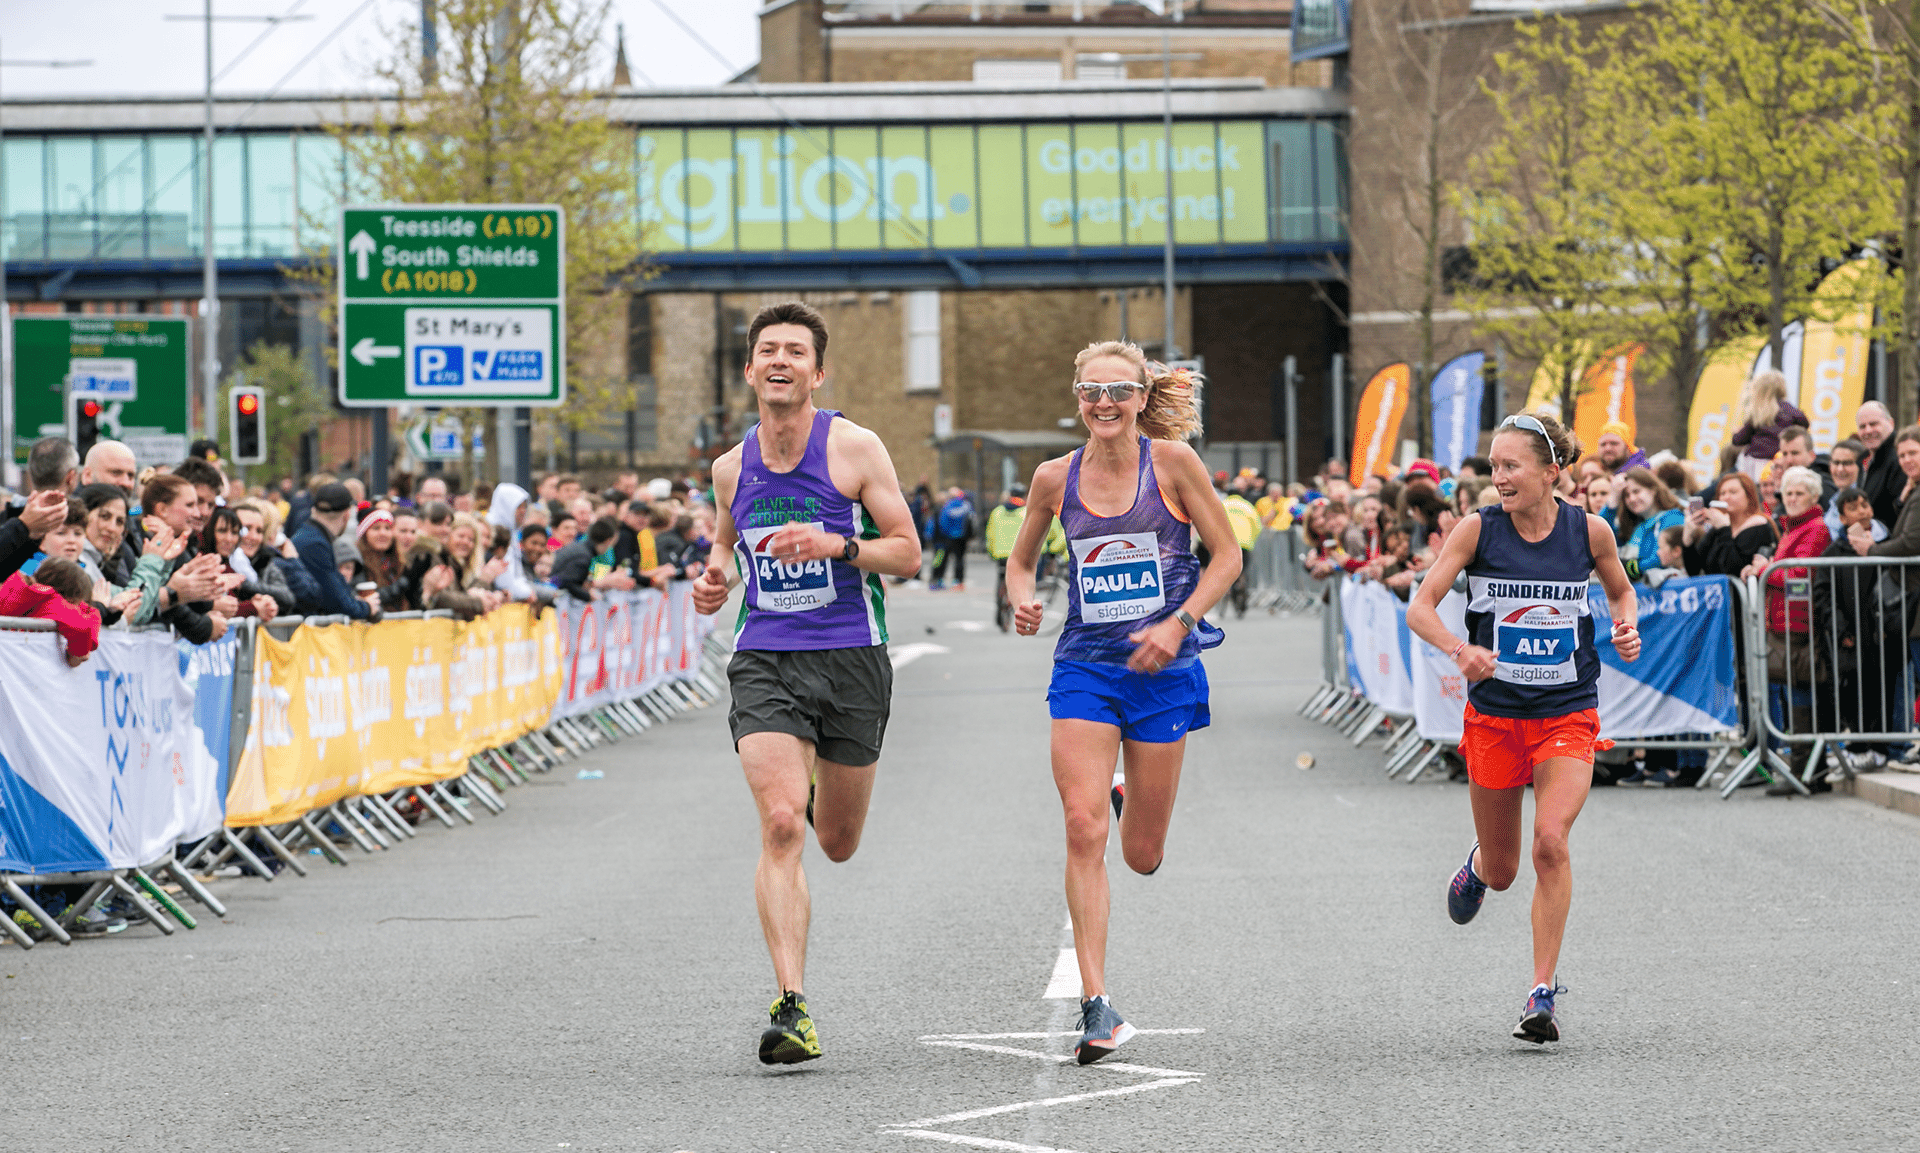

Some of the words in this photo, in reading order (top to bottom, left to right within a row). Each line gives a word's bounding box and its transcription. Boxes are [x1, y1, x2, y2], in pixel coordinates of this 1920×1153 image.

[1038, 138, 1150, 174] Good
[1155, 137, 1241, 172] luck
[590, 134, 971, 247] iglion.
[1039, 186, 1236, 229] everyone!
[380, 214, 477, 238] Teesside
[482, 213, 553, 239] (A19)
[382, 244, 450, 267] South
[456, 244, 539, 267] Shields
[381, 268, 477, 294] (A1018)
[416, 317, 440, 336] St
[451, 316, 523, 341] Mary's
[753, 496, 796, 513] ELVET
[748, 510, 812, 527] STRIDERS
[760, 558, 824, 580] 4104
[782, 582, 800, 590] Mark
[1082, 571, 1157, 594] PAULA
[1487, 583, 1586, 601] SUNDERLAND
[1515, 637, 1560, 656] ALY
